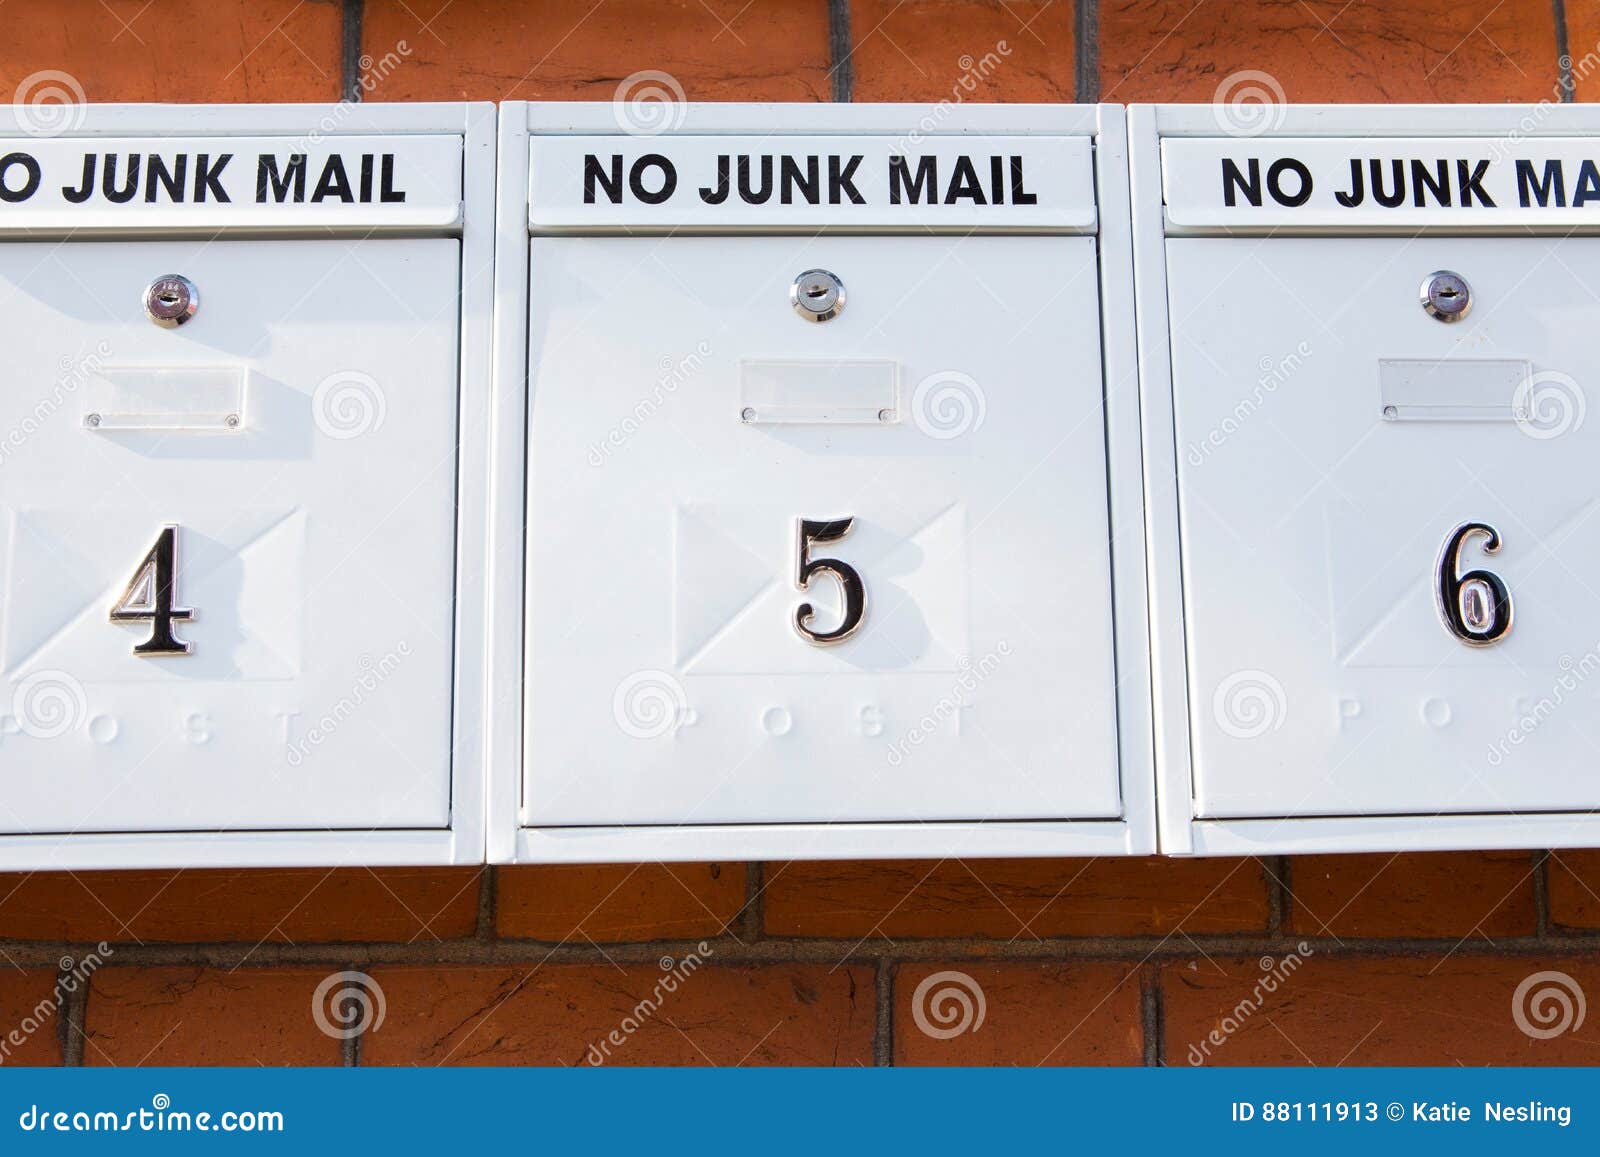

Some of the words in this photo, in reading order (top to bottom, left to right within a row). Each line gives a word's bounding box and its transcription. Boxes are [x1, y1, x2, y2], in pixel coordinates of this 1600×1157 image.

[61, 153, 234, 204] JUNK
[256, 153, 406, 203] MAIL
[583, 154, 678, 205] NO
[699, 154, 867, 205] JUNK
[889, 155, 1038, 206] MAIL
[1221, 157, 1314, 208] NO
[1334, 158, 1497, 209] JUNK
[109, 523, 196, 657] 4
[794, 515, 867, 647] 5
[1434, 520, 1515, 648] 6
